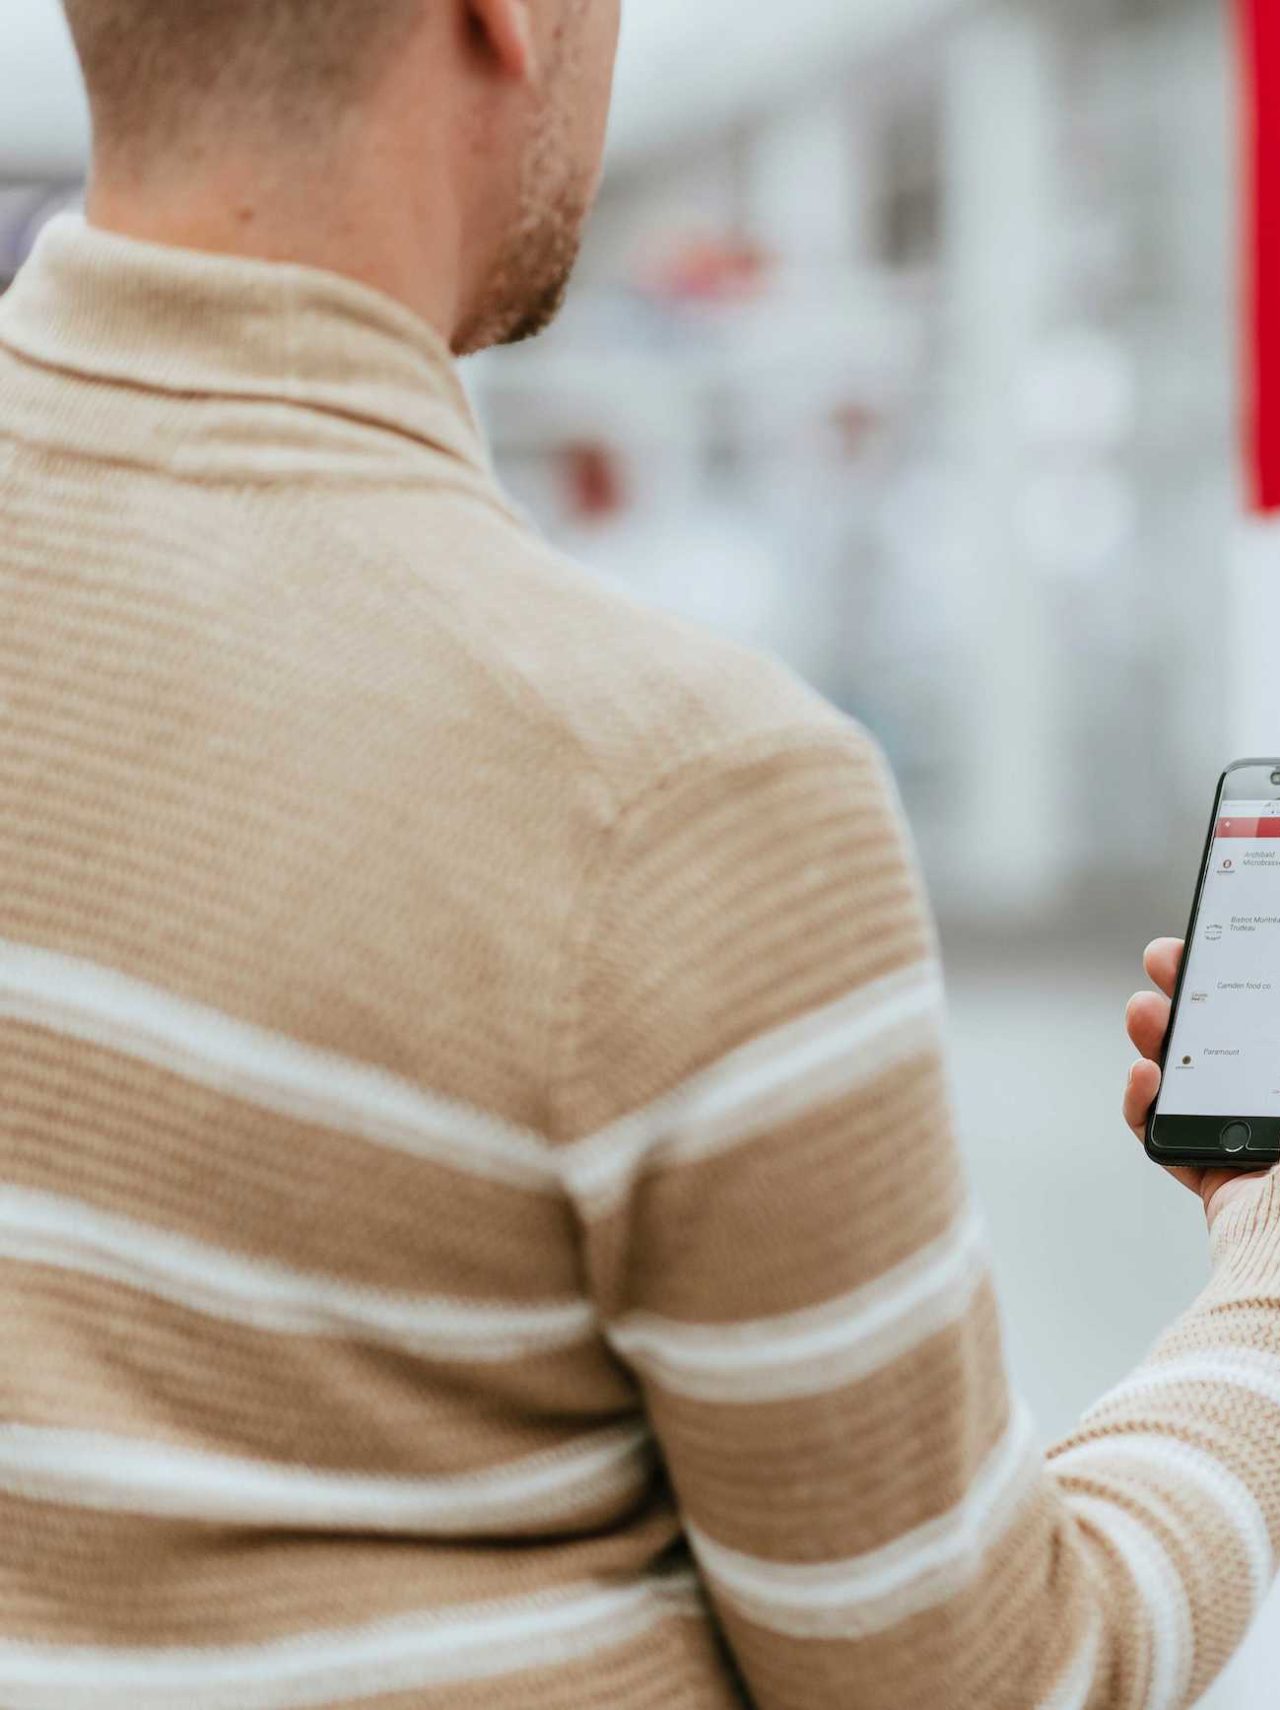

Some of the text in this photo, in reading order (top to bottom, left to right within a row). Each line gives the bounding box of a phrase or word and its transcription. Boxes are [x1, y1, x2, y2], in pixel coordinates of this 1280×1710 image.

[1216, 981, 1244, 990] Camden
[1246, 981, 1261, 990] food
[1203, 1048, 1240, 1056] Paramount
